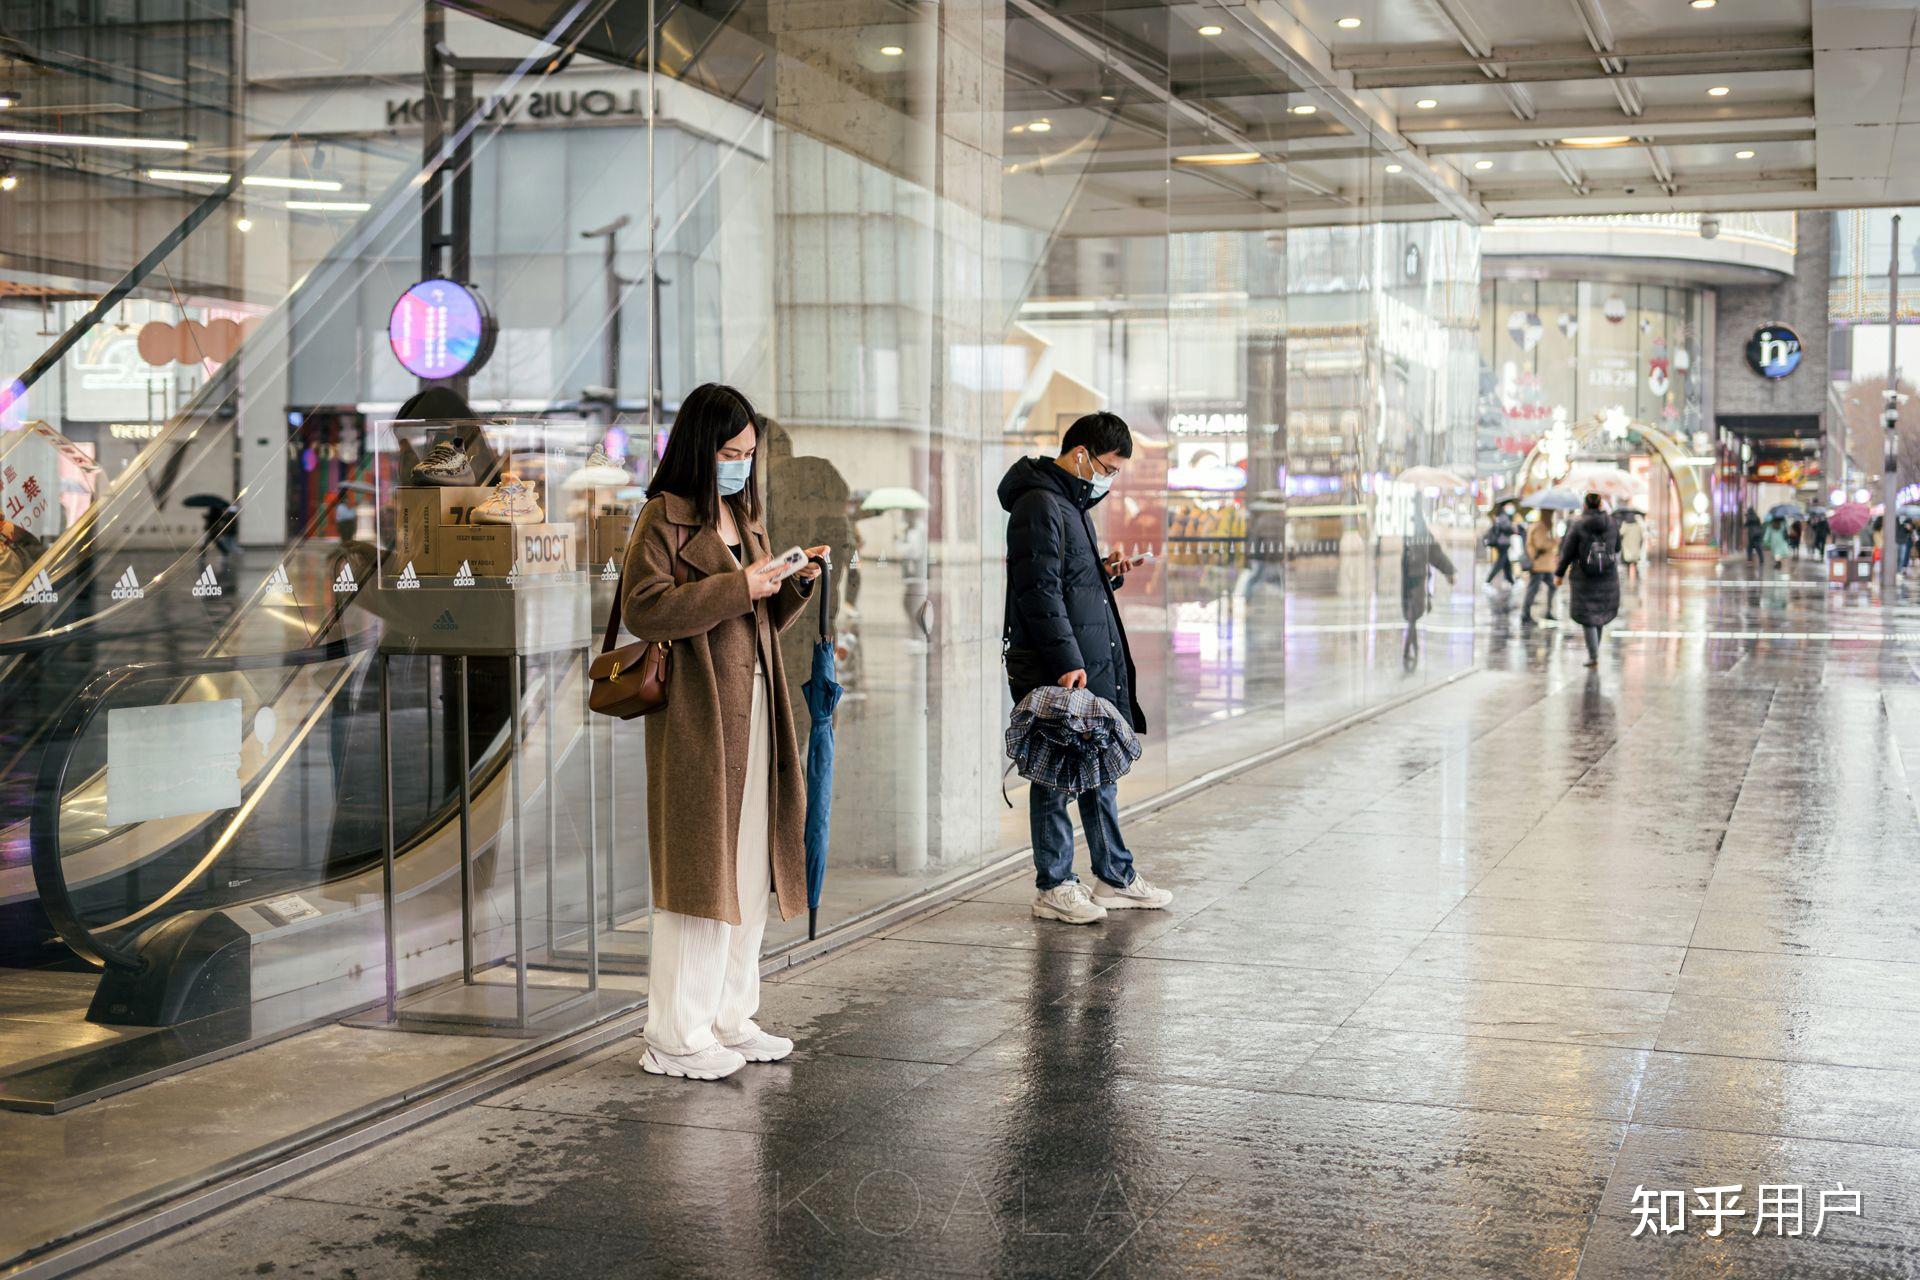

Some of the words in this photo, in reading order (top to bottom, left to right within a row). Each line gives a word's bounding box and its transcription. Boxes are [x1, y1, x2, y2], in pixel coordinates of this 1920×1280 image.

[525, 534, 569, 563] BOOST
[600, 571, 619, 581] adidas
[265, 581, 293, 594] adidas
[333, 581, 358, 592] adidas
[396, 578, 420, 589] adidas
[453, 577, 476, 587] adidas
[111, 587, 144, 599] adidas
[192, 584, 222, 597] adidas
[22, 590, 58, 603] adidas
[432, 623, 459, 631] adidas
